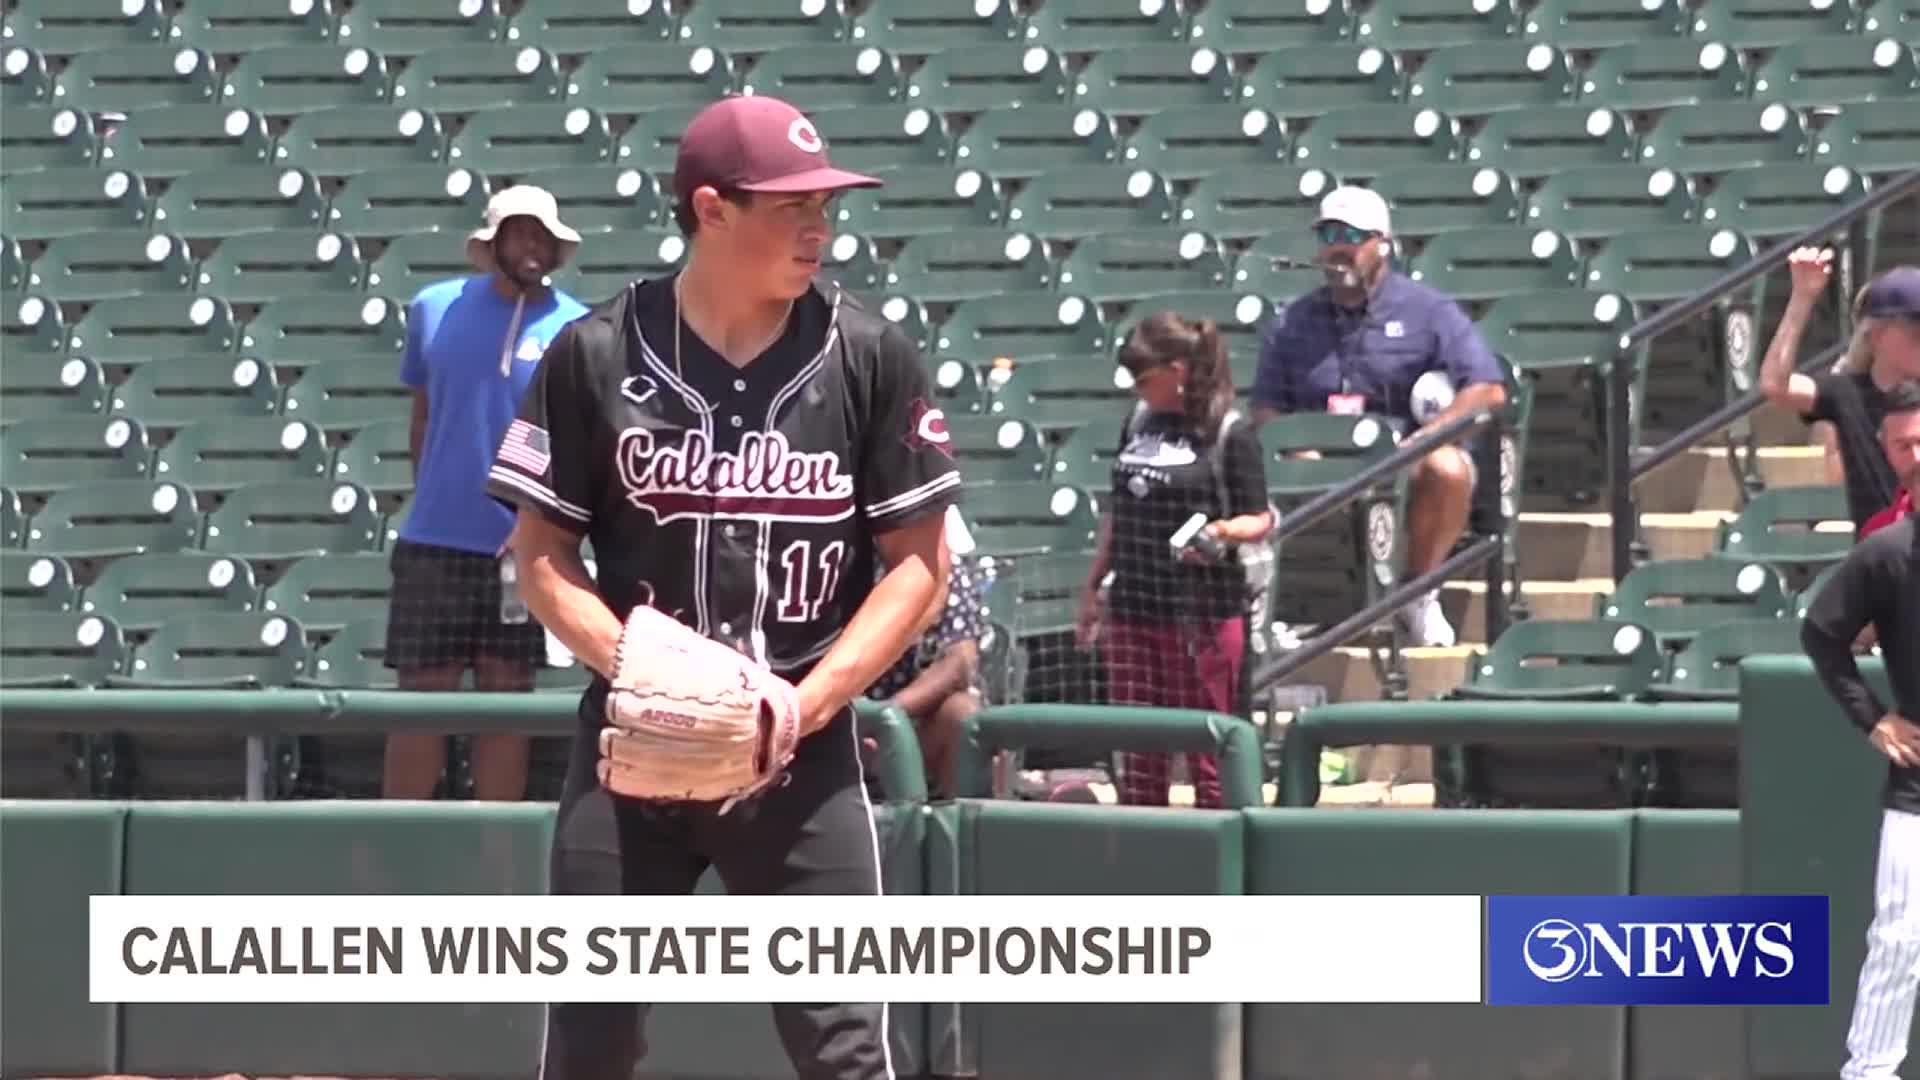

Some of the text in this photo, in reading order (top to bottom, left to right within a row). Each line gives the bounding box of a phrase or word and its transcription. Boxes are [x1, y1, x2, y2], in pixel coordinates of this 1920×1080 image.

[787, 116, 823, 153] C
[918, 408, 950, 443] C
[617, 427, 854, 497] Calallen
[777, 539, 845, 622] 11
